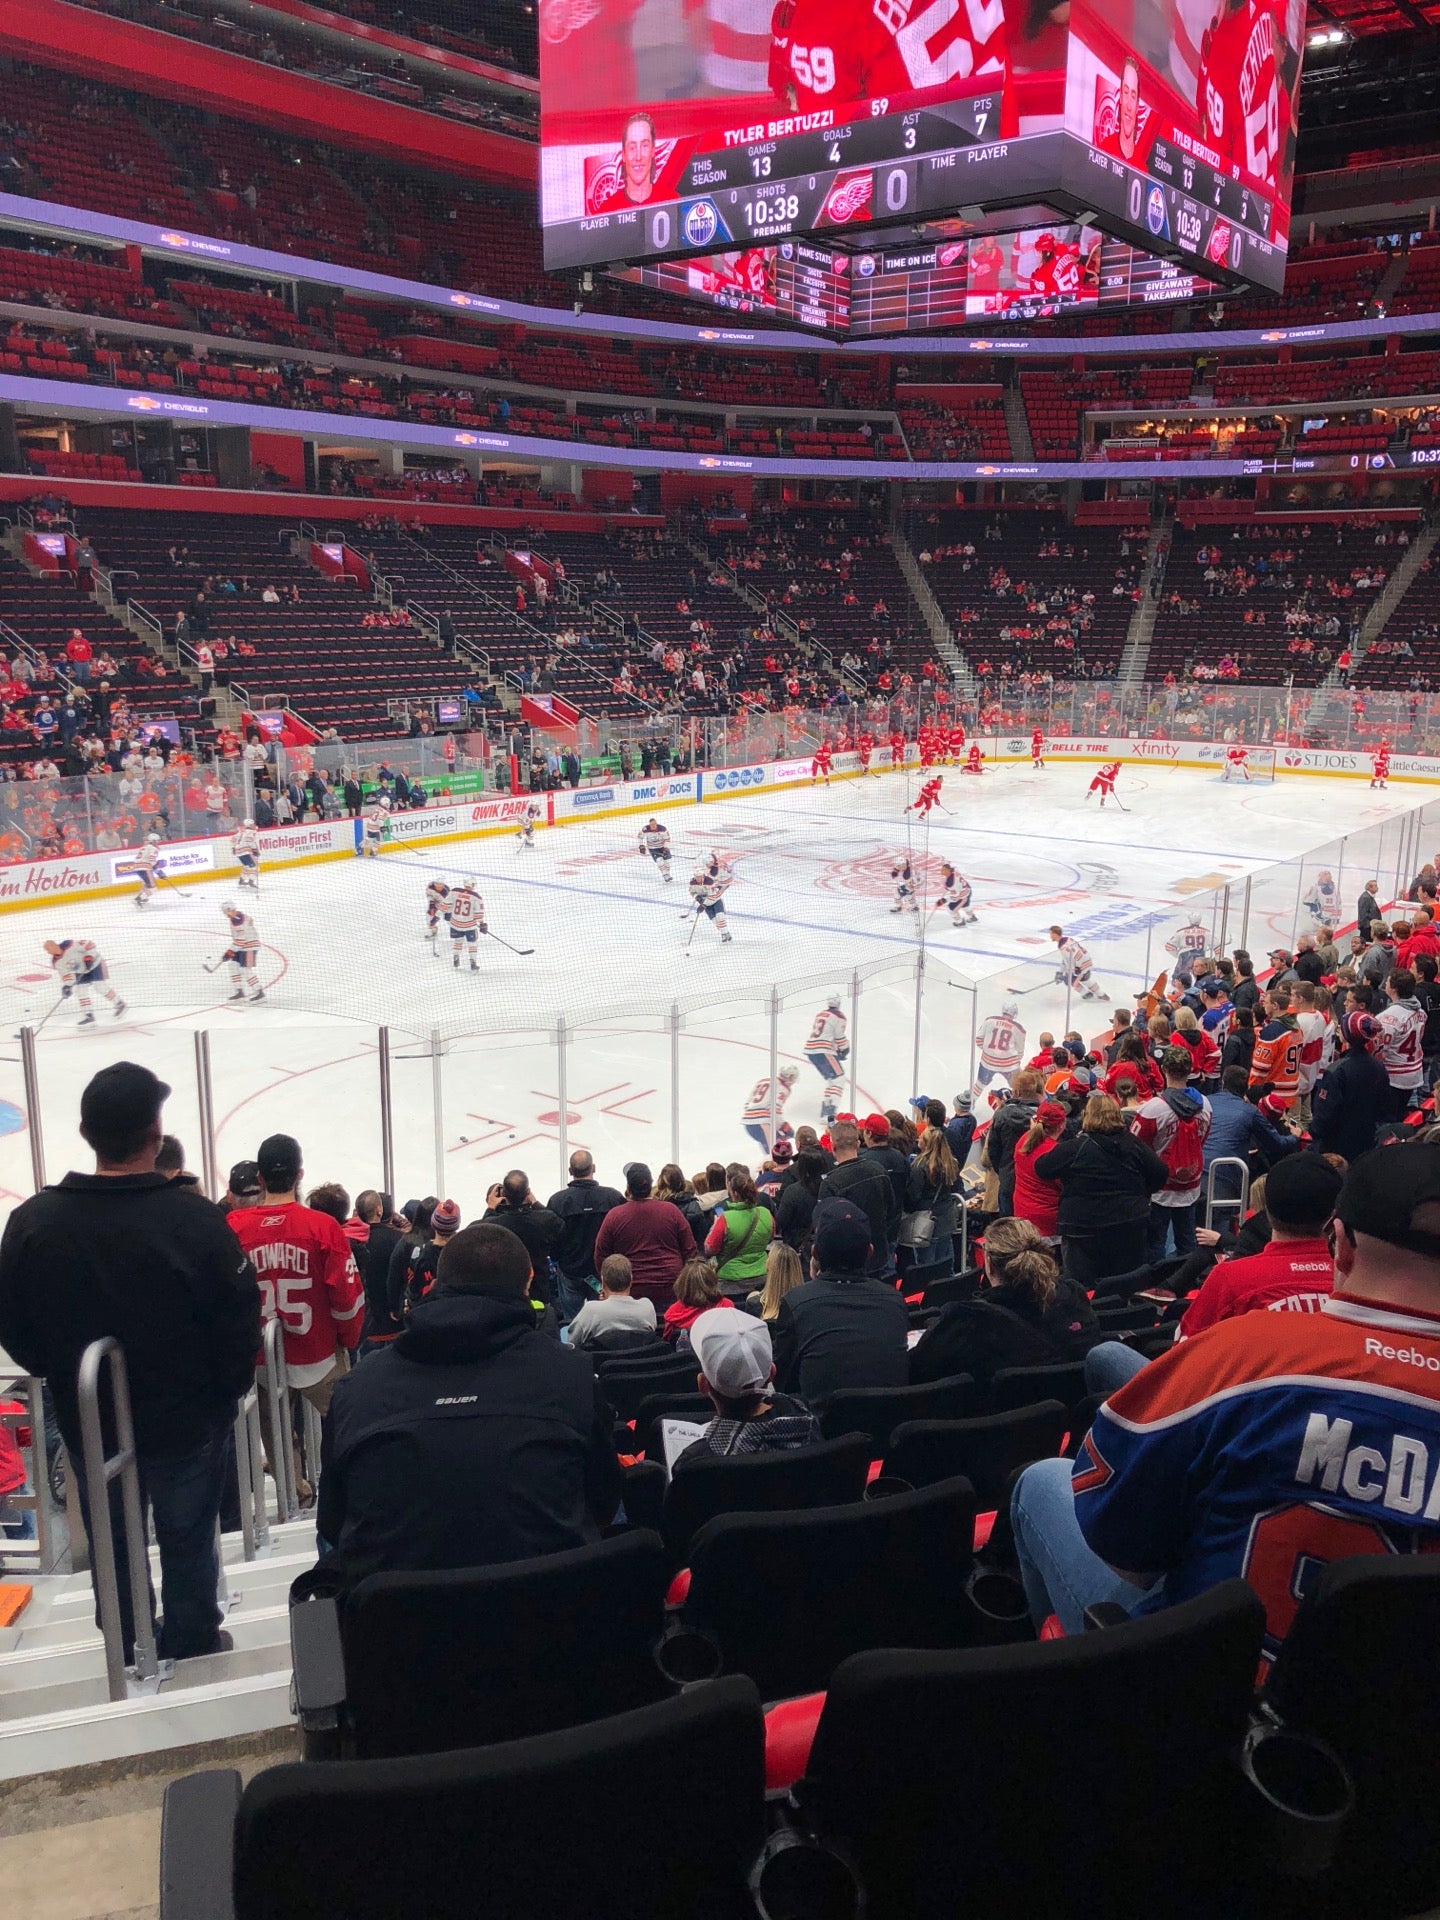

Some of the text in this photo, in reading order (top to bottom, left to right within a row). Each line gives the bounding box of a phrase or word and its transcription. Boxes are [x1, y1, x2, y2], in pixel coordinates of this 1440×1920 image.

[790, 42, 836, 95] 59
[1206, 76, 1224, 138] 59
[724, 98, 889, 146] TYLER BERTUZZI 59
[748, 98, 992, 157] GAMES GOALS AST PTS
[752, 113, 988, 178] 13 4 3 7
[1155, 143, 1167, 158] THIS
[1173, 127, 1240, 180] TYLER BERTUZZI 59
[692, 160, 712, 171] THIS
[930, 145, 1008, 169] TIME PLAYER
[1088, 149, 1124, 178] PLAYER TIME
[1154, 156, 1173, 175] SEASON
[692, 170, 727, 186] SEASON
[731, 176, 816, 204] 0 SHOTS 0
[887, 169, 908, 211] 0
[1130, 178, 1142, 220] 0
[1171, 190, 1176, 204] 0
[1183, 198, 1197, 214] SHOTS
[1183, 168, 1269, 231] 13 4 3 7
[744, 195, 799, 226] 10:38
[580, 212, 637, 231] PLAYER TIME
[652, 210, 670, 249] 0
[753, 223, 792, 237] PREGAME
[1176, 209, 1202, 242] 10:38
[191, 241, 231, 254] CHEVROLET
[799, 246, 832, 264] GAME STATS
[1232, 232, 1241, 269] 0
[886, 253, 936, 269] TIME ON ICE
[1161, 269, 1178, 279] PIM
[1146, 278, 1193, 291] GIVEAWAYS
[1144, 289, 1194, 301] TAKEAWAYS
[1289, 329, 1325, 338] CHEVROLET
[164, 401, 209, 414] CHEVROLET
[722, 460, 753, 468] CHEVROLET
[1351, 456, 1359, 467] 0
[1411, 450, 1440, 463] 10:37
[1052, 744, 1110, 753] BELLE TIRE
[1131, 741, 1181, 759] xfinity
[777, 764, 813, 777] Great Clip
[1303, 754, 1357, 769] ST. JOE'S
[1388, 758, 1411, 770] Little
[633, 782, 692, 800] DMC DOCS
[472, 800, 529, 821] QWIK PARK
[387, 815, 455, 834] nterprise
[259, 830, 332, 851] Michigan First
[169, 855, 187, 863] Made
[195, 857, 209, 865] USA
[25, 866, 100, 894] Hortons
[454, 899, 471, 917] 83
[1185, 935, 1206, 951] 98
[988, 1027, 1012, 1051] 18
[1255, 1045, 1271, 1059] 97
[1290, 1262, 1332, 1272] Reebok
[1365, 1337, 1440, 1371] Reebo
[434, 1395, 478, 1405] BAUER
